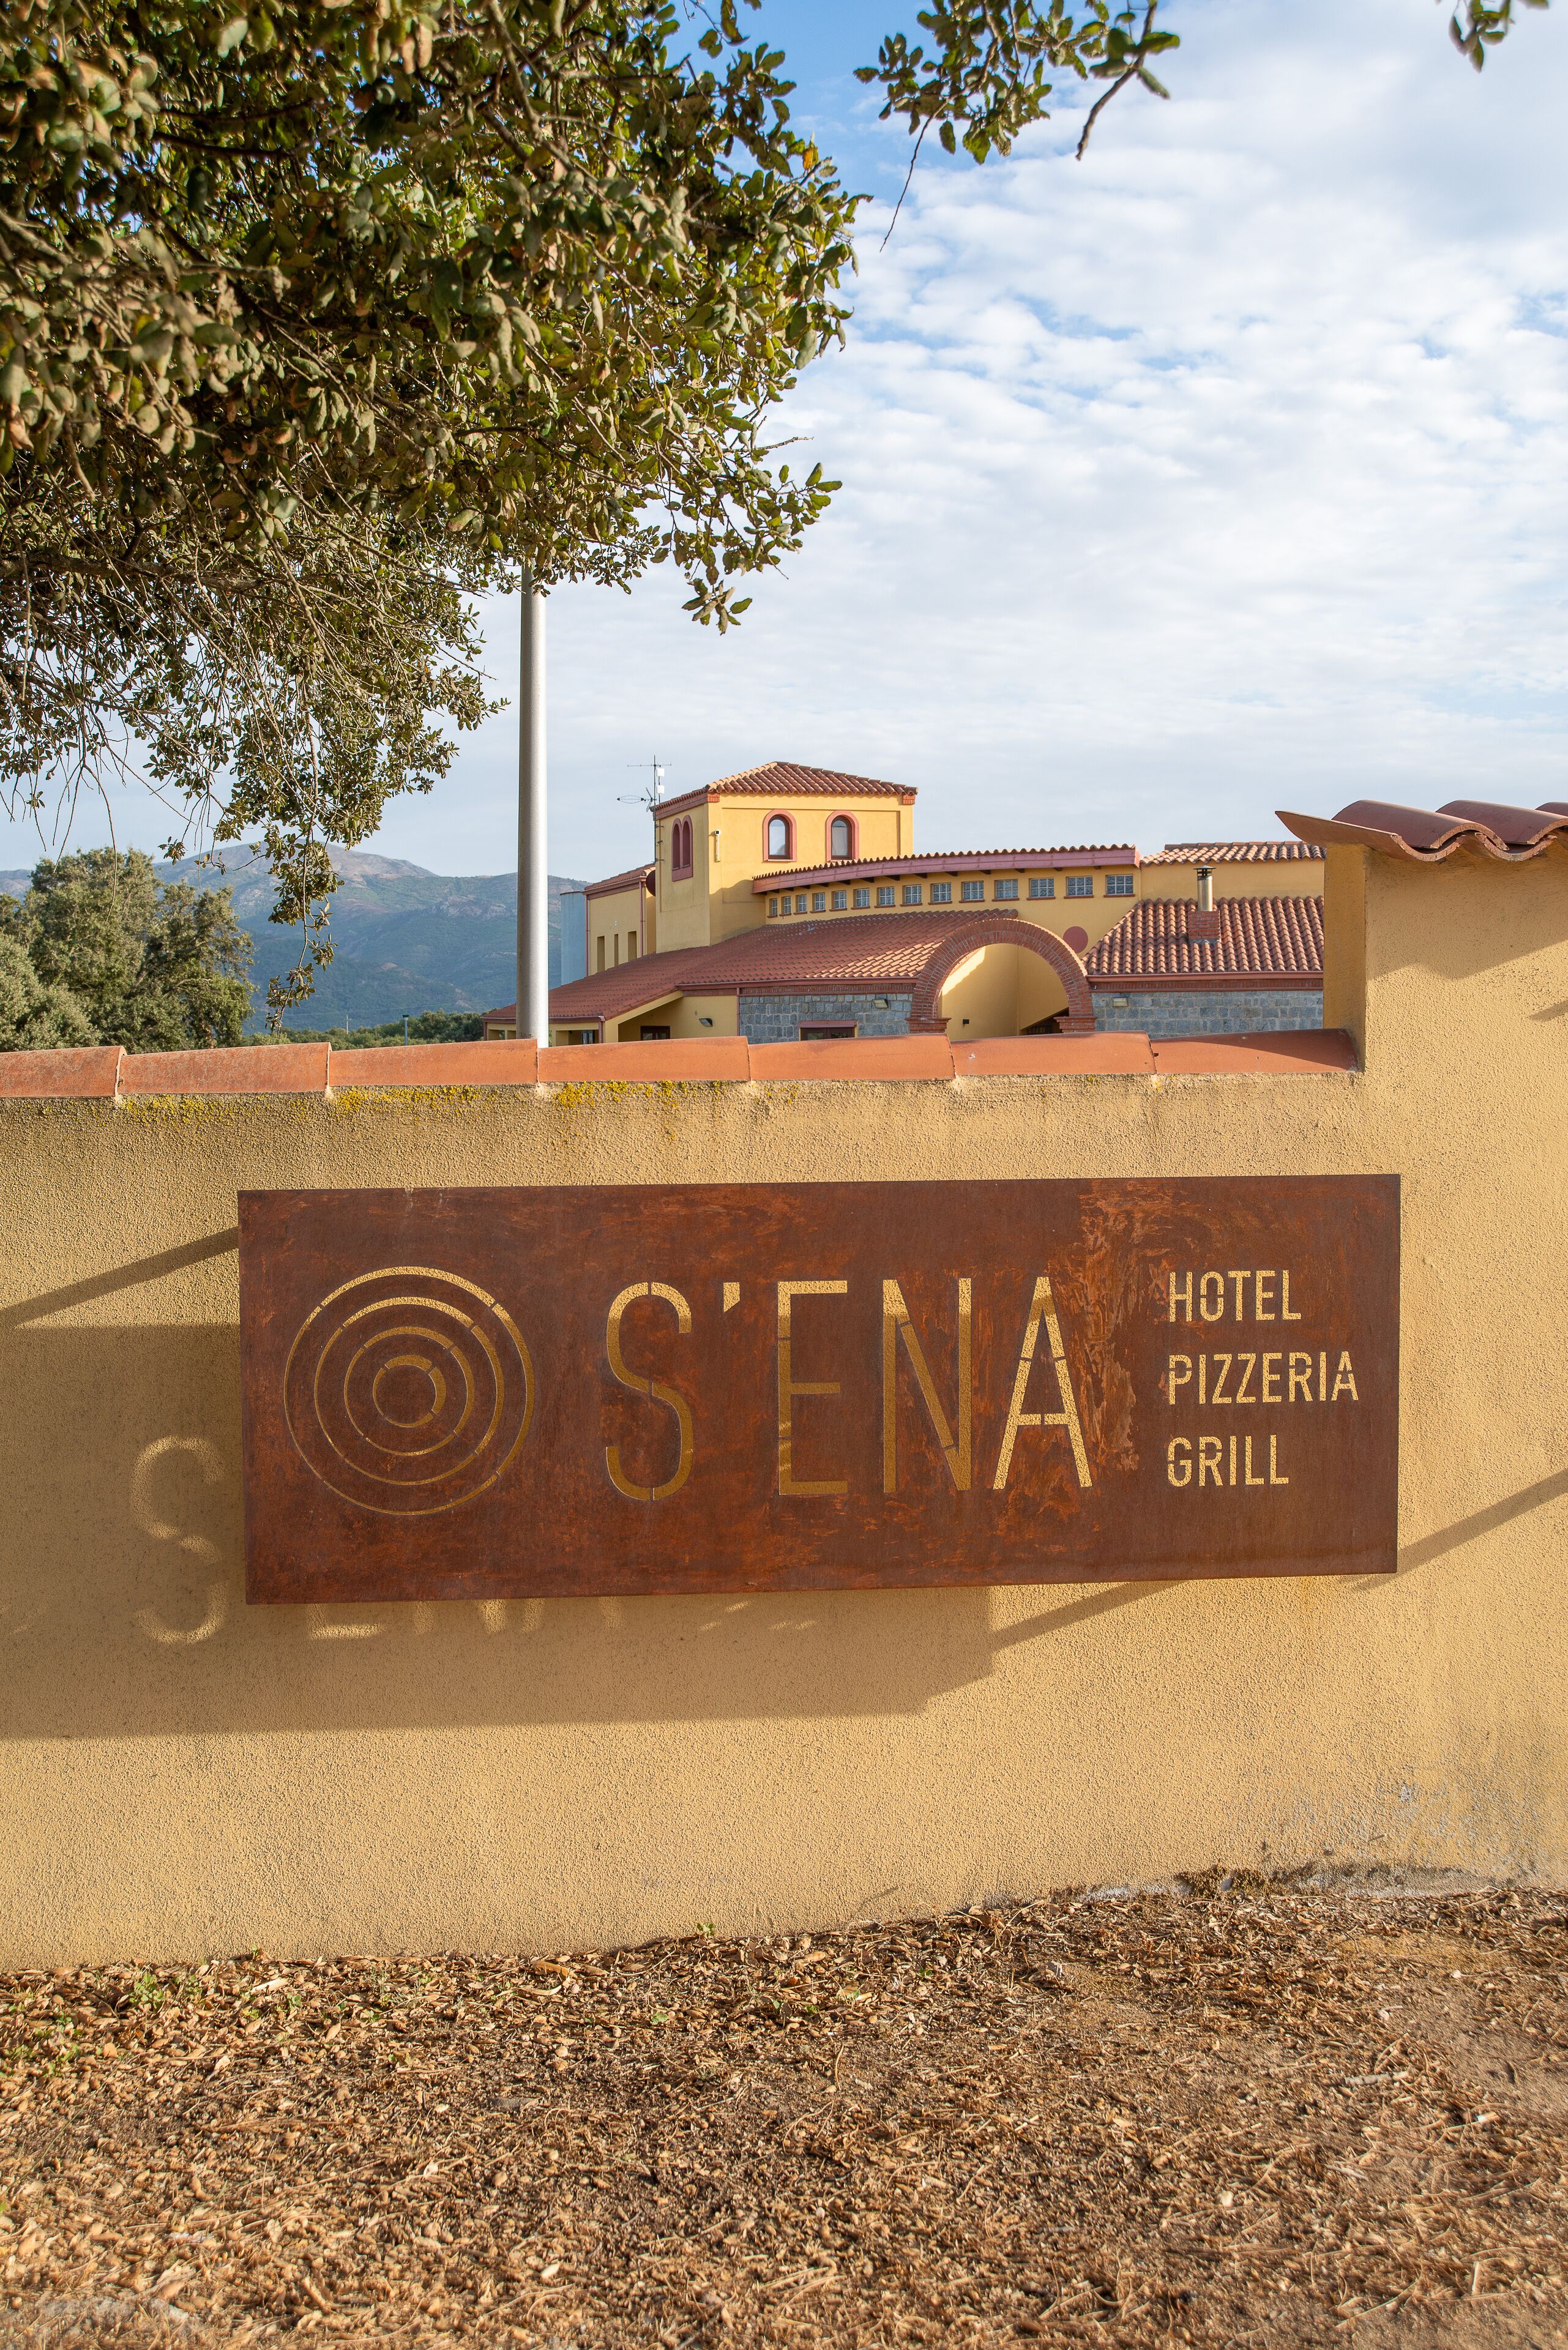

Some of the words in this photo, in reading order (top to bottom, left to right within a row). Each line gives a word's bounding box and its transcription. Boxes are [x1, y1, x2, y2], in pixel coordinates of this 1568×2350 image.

[1169, 1270, 1302, 1322] HOTEL
[606, 1277, 1092, 1501] S'ENA
[1169, 1351, 1359, 1404] PIZZERIA
[1168, 1434, 1289, 1487] GRILL
